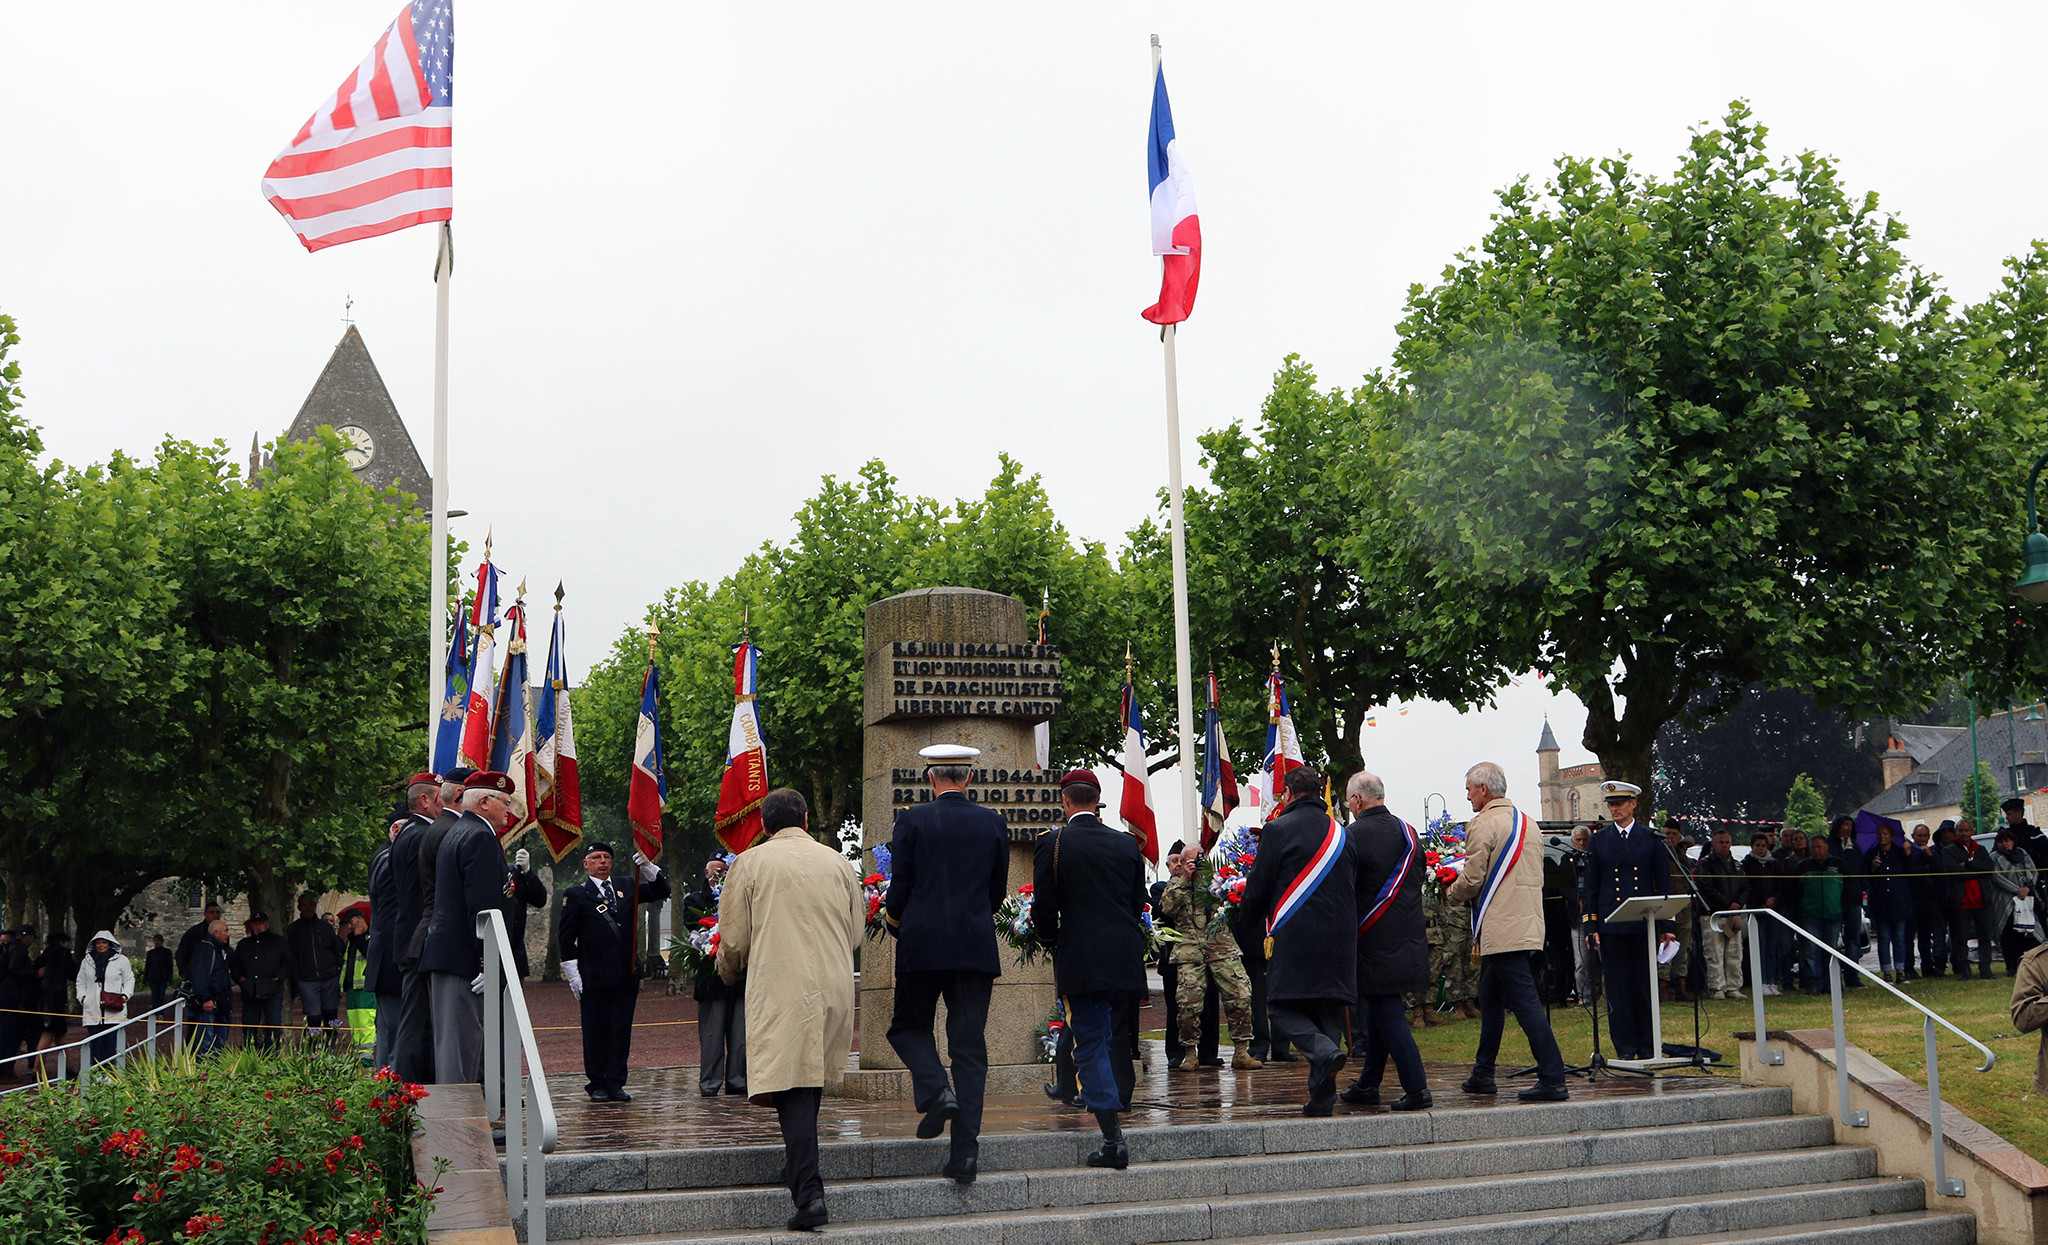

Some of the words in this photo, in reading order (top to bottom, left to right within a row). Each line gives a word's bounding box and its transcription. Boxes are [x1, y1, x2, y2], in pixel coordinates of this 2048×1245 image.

[918, 642, 954, 656] JUIN
[893, 661, 909, 675] ET
[944, 662, 1016, 676] DIVISIONS
[1020, 663, 1063, 677] U.S.A.
[894, 680, 916, 694] DE
[923, 680, 1063, 696] PARACHUTISTES
[895, 700, 972, 714] LIBERENT
[976, 701, 997, 715] CE
[1001, 701, 1064, 715] CANTON
[740, 712, 761, 792] COMBATTANTS
[893, 788, 914, 802] 82
[984, 789, 1008, 802] 101
[1015, 789, 1036, 802] ST
